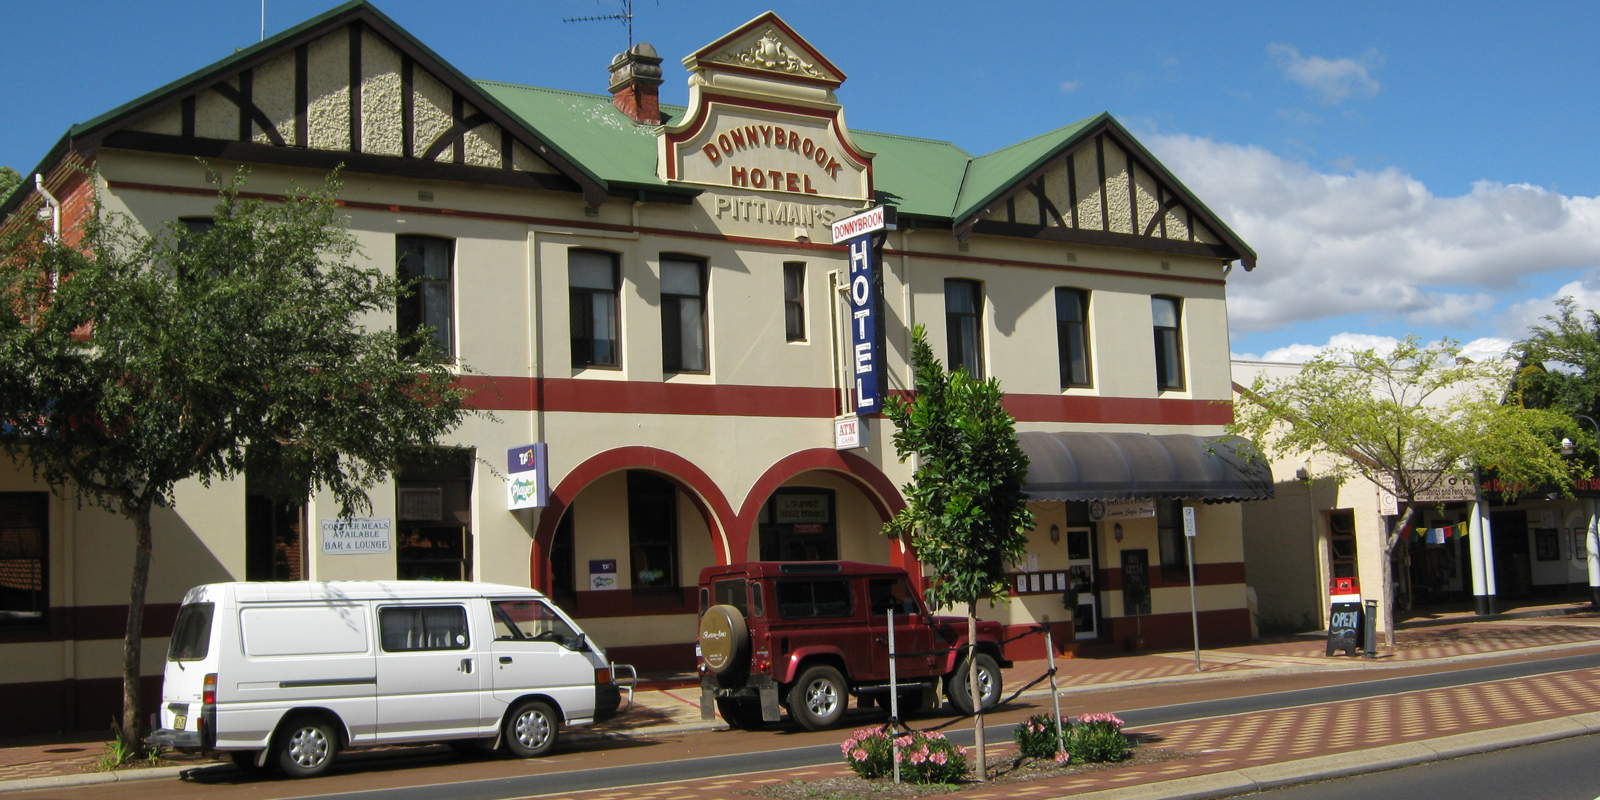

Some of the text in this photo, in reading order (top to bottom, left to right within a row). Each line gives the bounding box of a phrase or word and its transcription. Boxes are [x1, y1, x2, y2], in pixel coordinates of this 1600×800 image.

[702, 125, 841, 179] DONNYBROOK
[731, 166, 818, 194] HOTEL
[715, 196, 835, 227] PITTMAN'S
[834, 209, 883, 239] DONNYBROOK
[851, 240, 874, 408] HOTEL
[839, 423, 856, 436] ATM
[361, 522, 389, 530] MEALS
[325, 542, 343, 550] BAR
[355, 541, 387, 549] LOUNGE
[1331, 611, 1358, 628] OPEN
